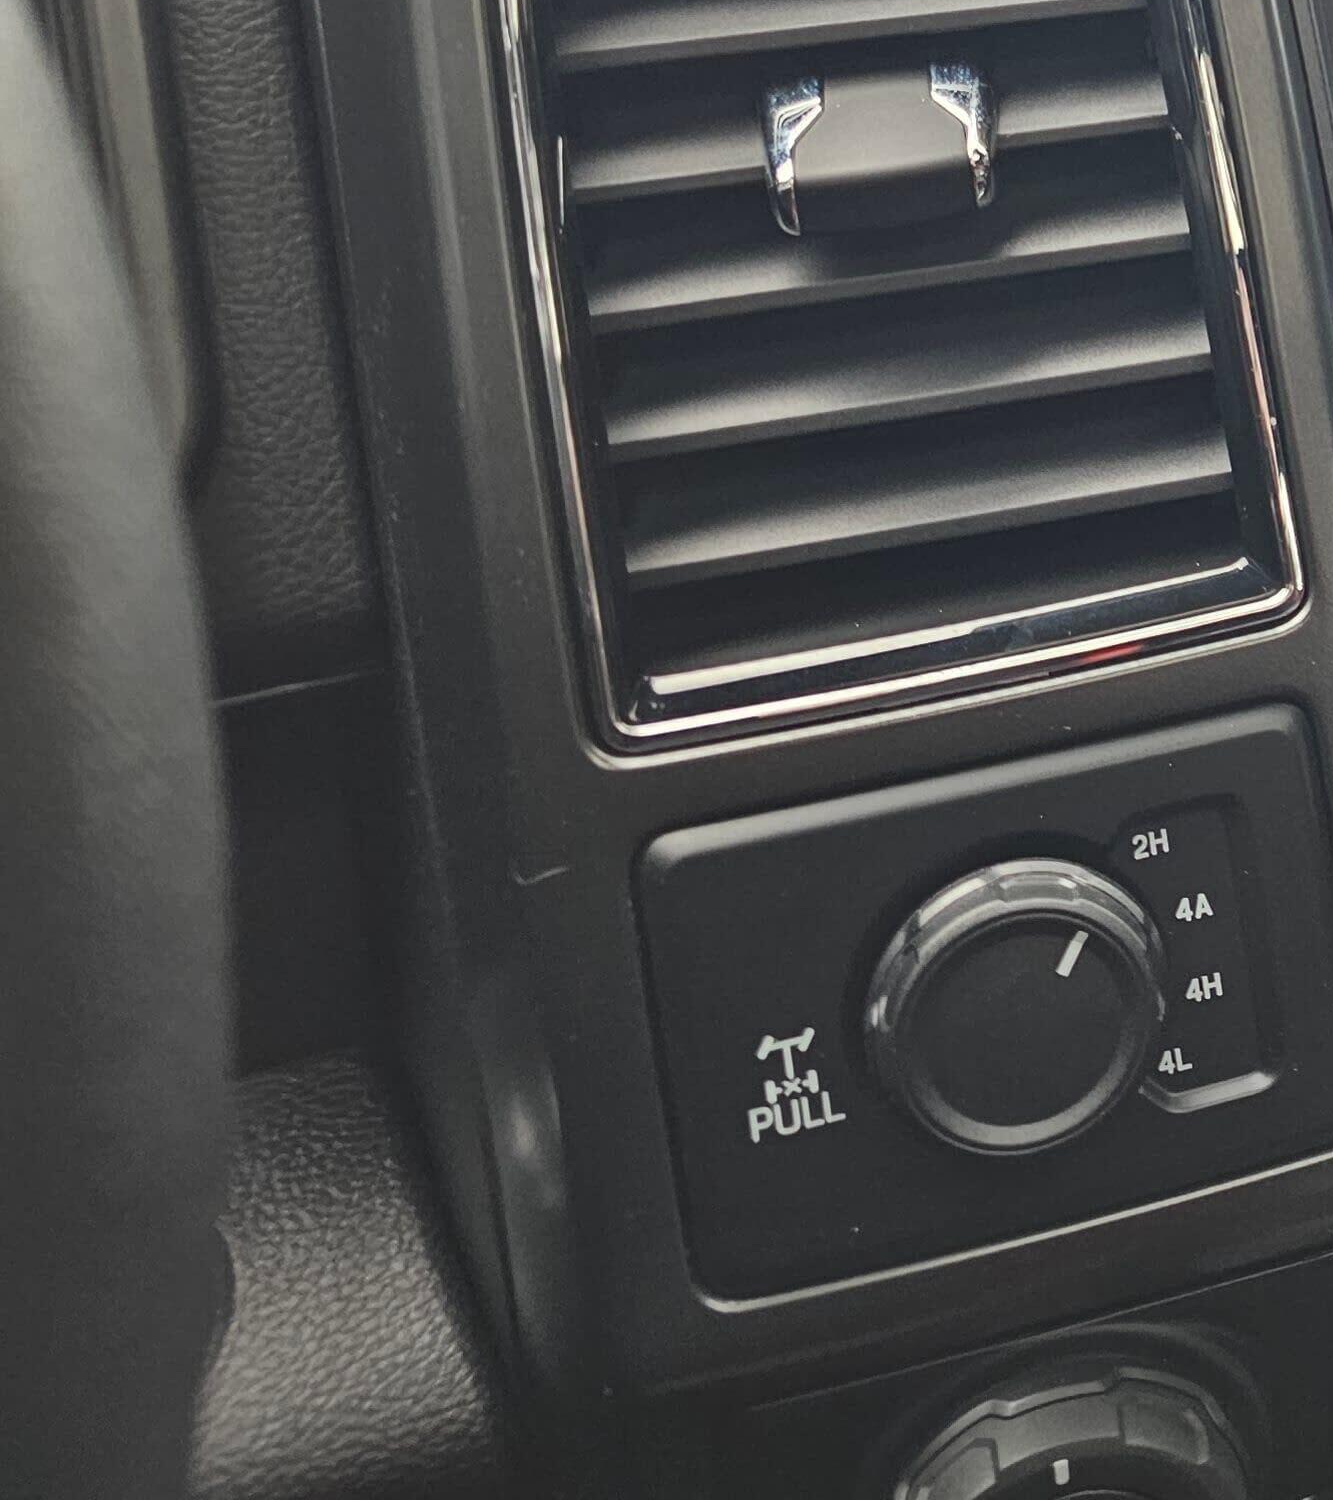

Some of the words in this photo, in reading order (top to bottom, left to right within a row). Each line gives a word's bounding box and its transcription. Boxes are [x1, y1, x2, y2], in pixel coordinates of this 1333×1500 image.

[1131, 828, 1170, 861] 2H
[1175, 892, 1214, 922] 4A
[1185, 972, 1223, 1002] 4H
[1157, 1047, 1193, 1074] 4L
[747, 1092, 846, 1143] PULL
